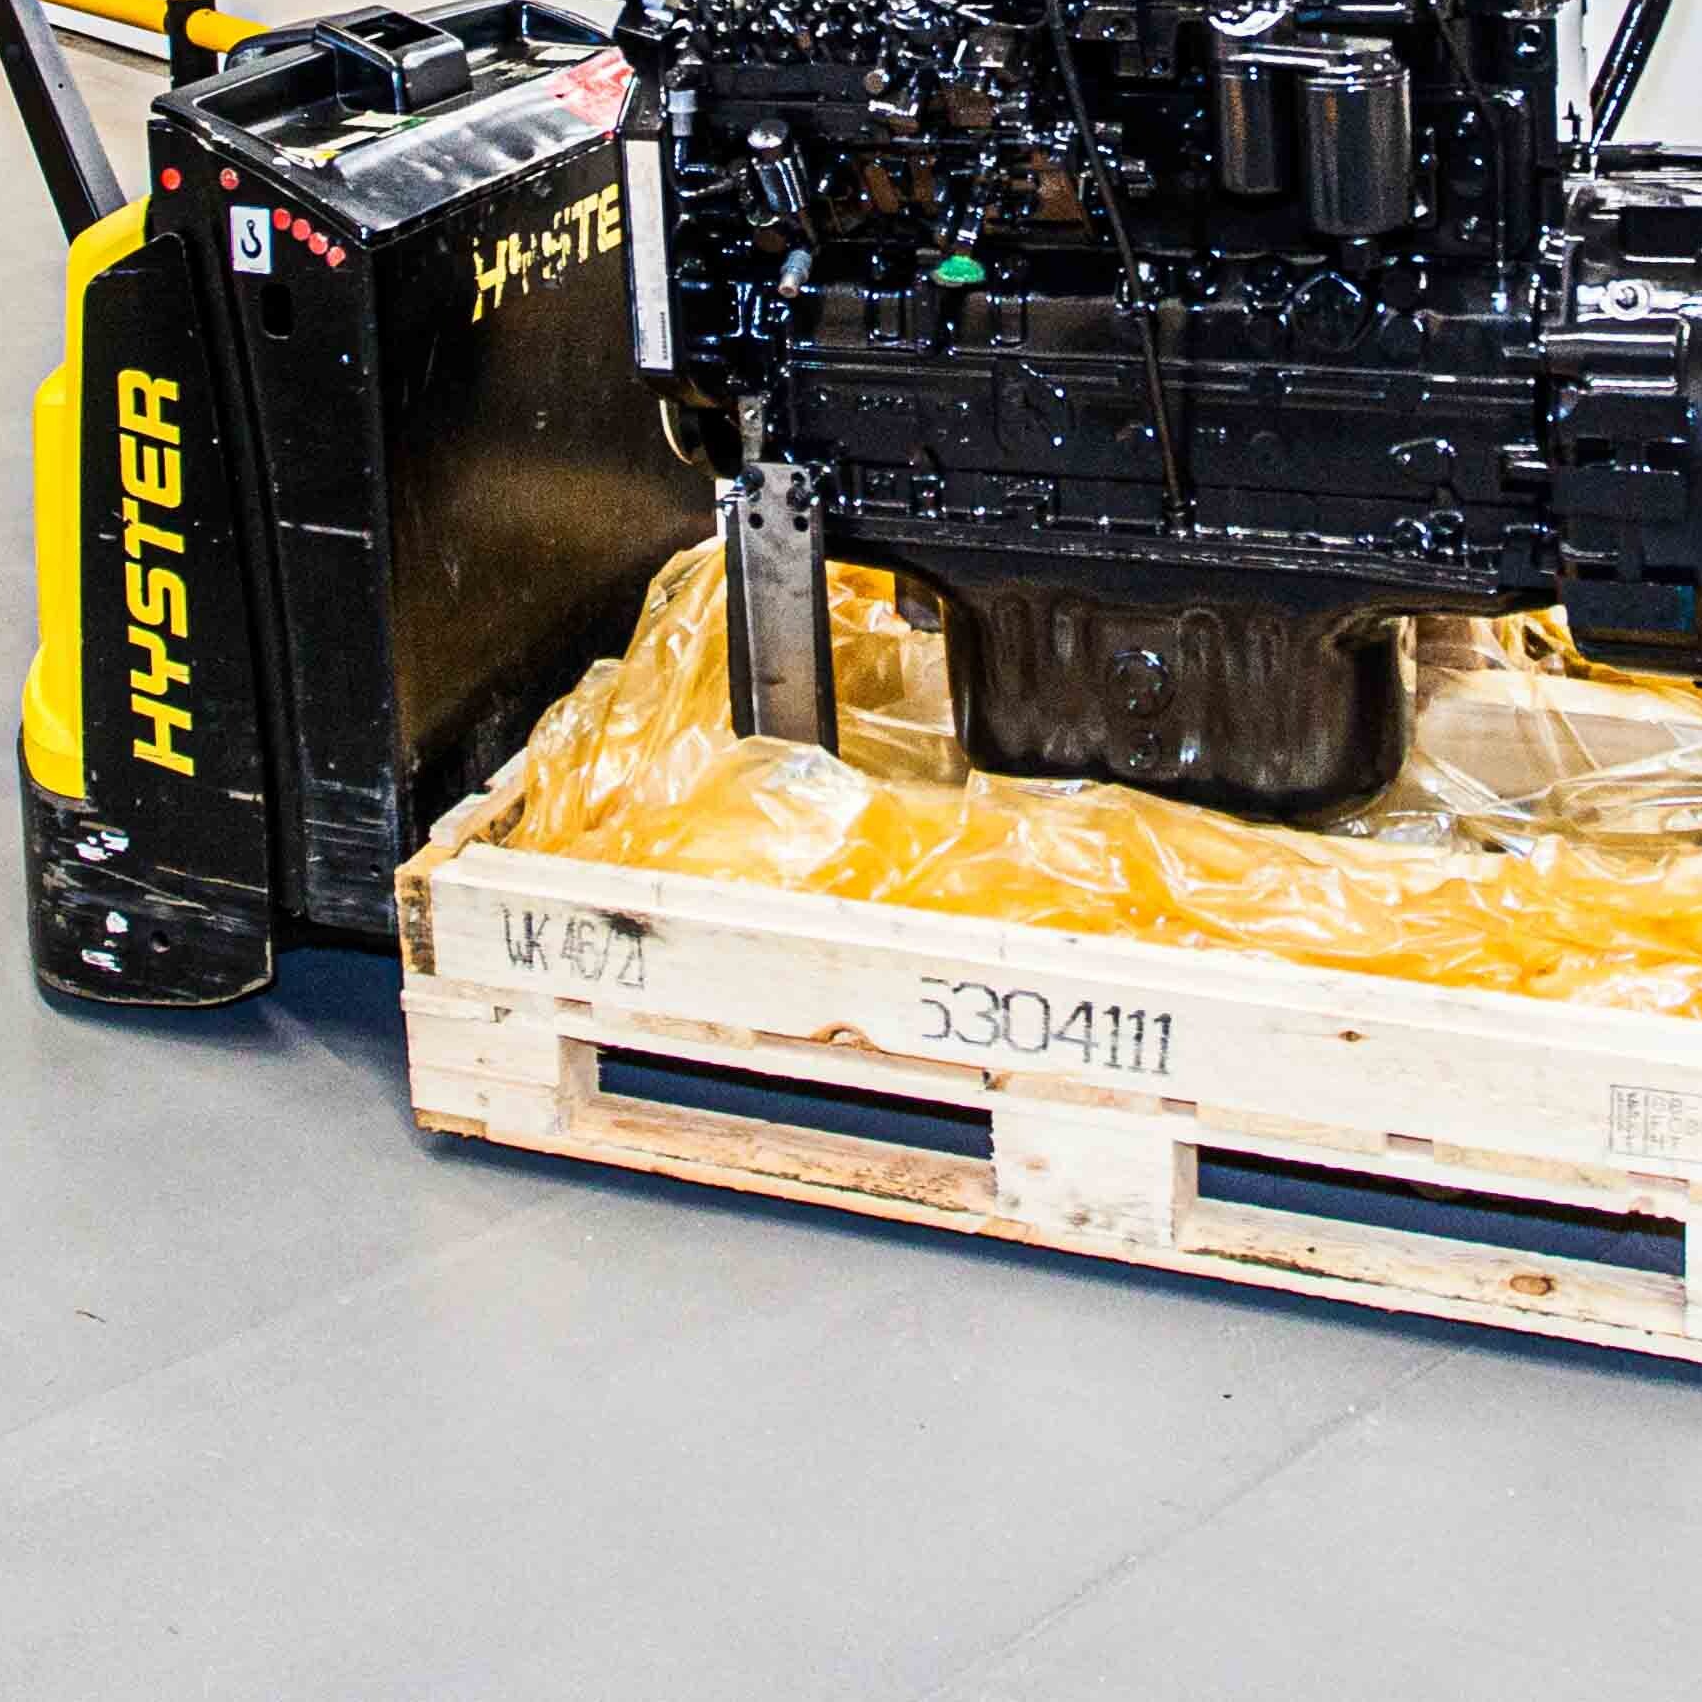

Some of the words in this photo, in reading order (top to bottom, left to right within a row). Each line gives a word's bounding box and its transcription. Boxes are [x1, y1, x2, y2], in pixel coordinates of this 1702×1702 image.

[472, 183, 622, 324] HYSTE
[117, 368, 195, 778] HYSTER
[919, 976, 1172, 1075] 5304111
